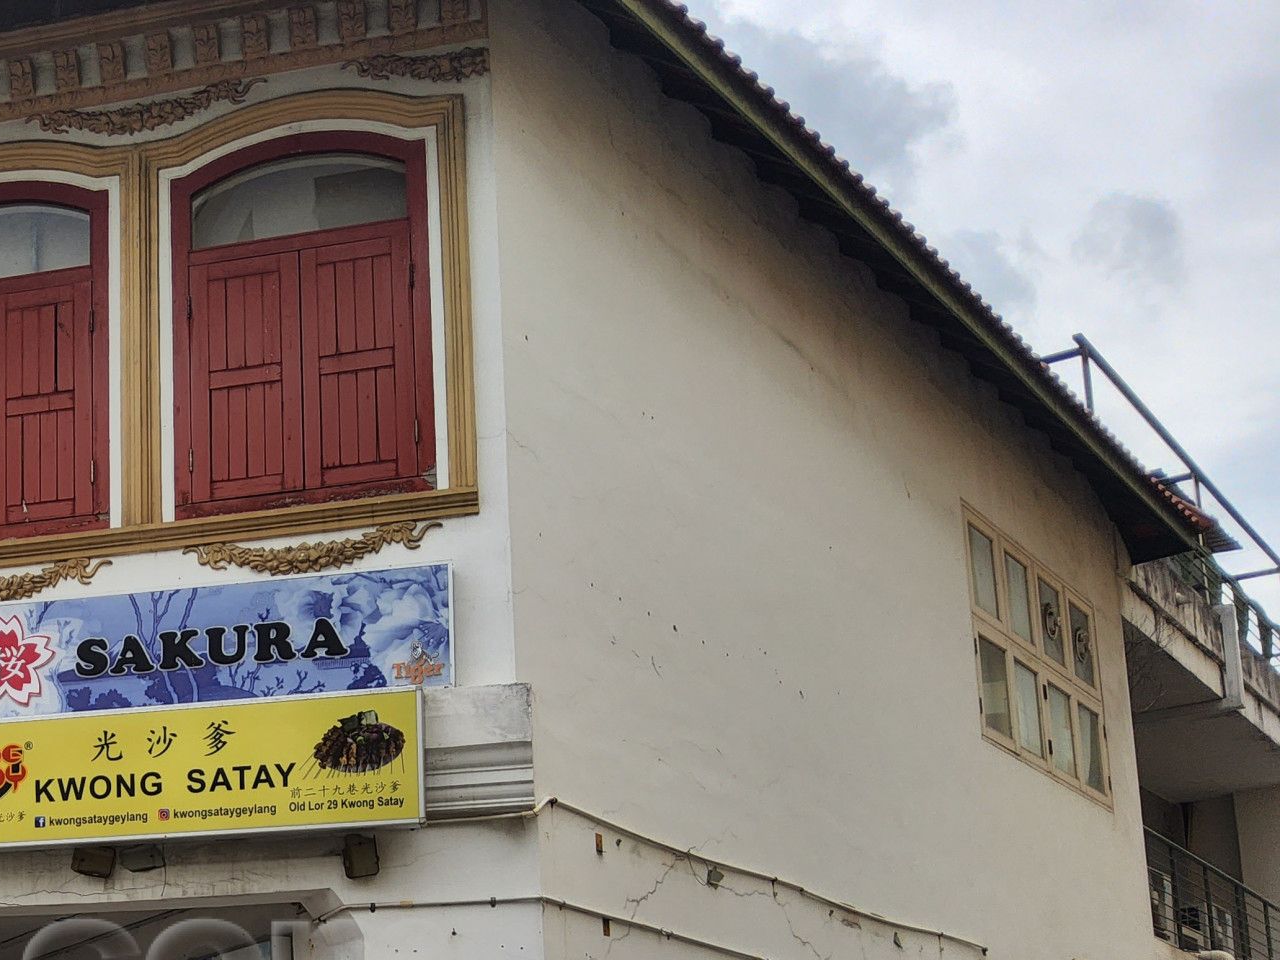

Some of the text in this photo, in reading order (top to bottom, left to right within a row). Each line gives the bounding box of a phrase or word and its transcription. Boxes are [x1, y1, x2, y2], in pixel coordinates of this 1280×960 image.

[75, 616, 350, 678] SAKURA
[392, 660, 445, 685] Tiger
[90, 719, 236, 763] 光沙爹
[34, 762, 297, 803] KWONG SATAY
[173, 803, 277, 820] kwongsataygeylang
[289, 796, 405, 812] Old Lor 29 Kwong Satay
[49, 811, 148, 828] kwongsataygeylang
